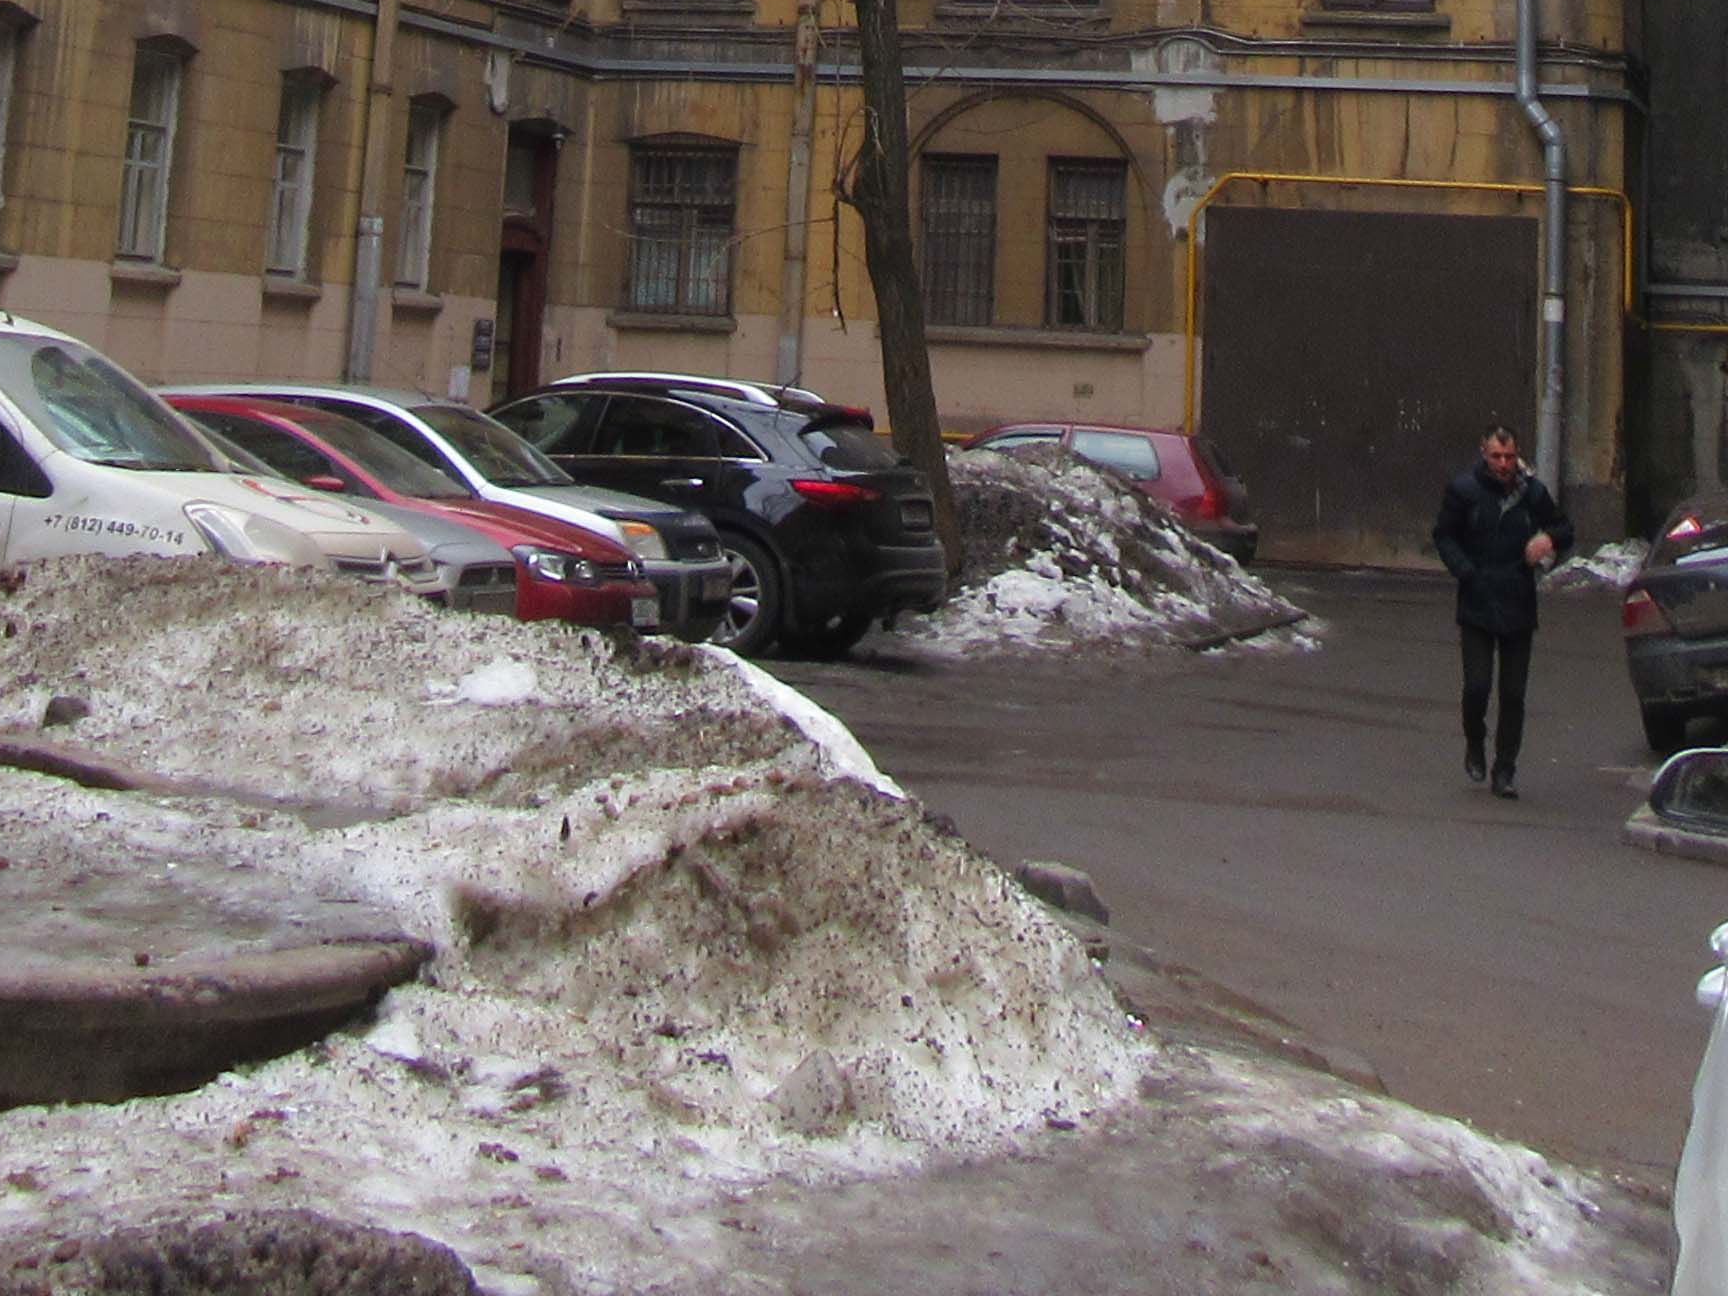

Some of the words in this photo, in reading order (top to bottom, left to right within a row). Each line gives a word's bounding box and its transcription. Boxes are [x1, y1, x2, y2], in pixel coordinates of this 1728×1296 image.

[43, 514, 63, 529] +7
[65, 516, 103, 536] (812)
[106, 520, 185, 545] 449-70-14
